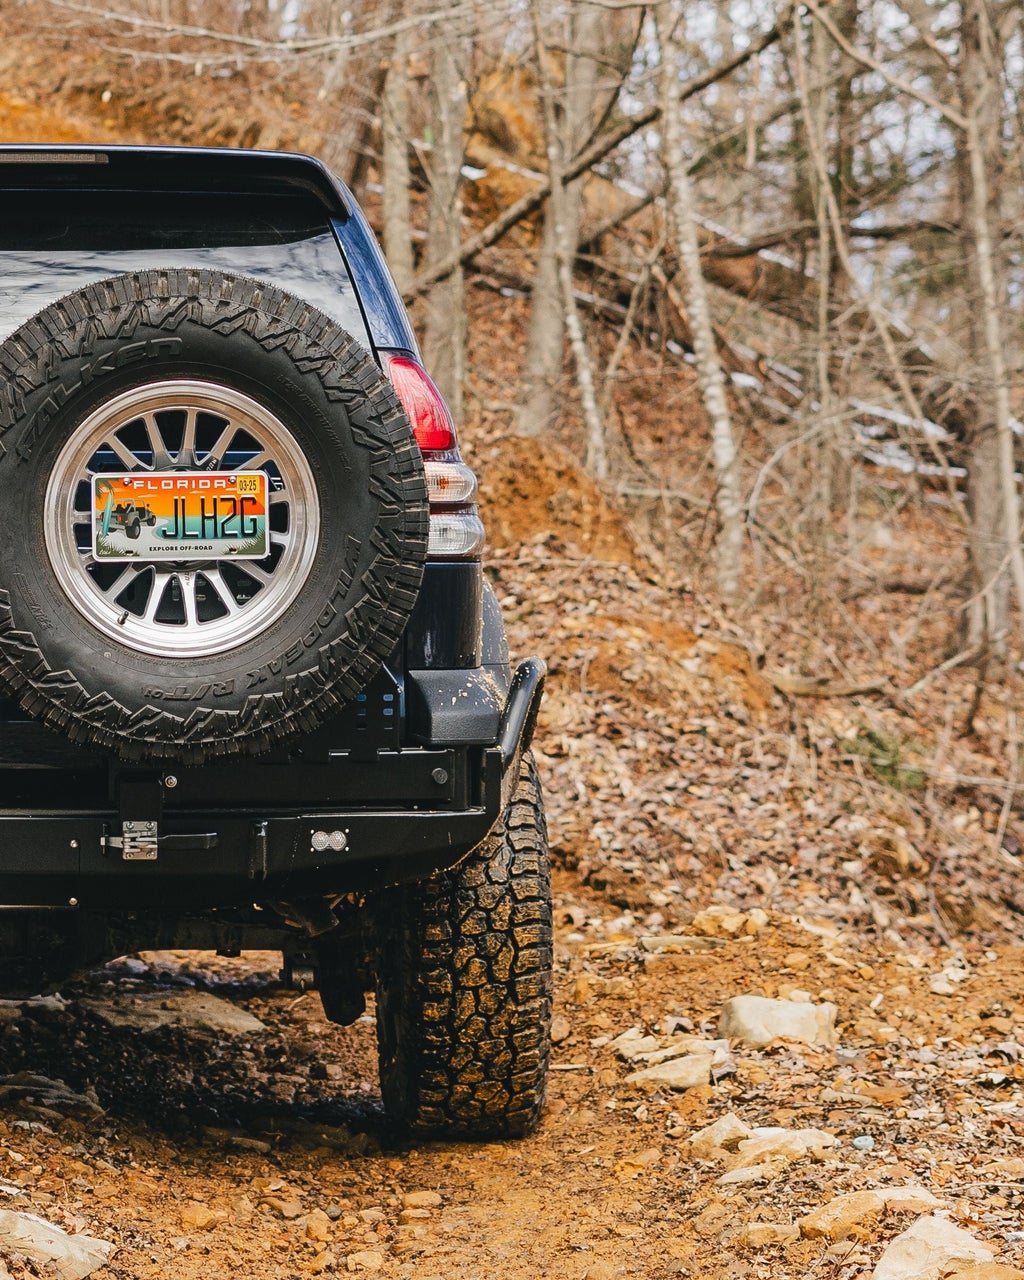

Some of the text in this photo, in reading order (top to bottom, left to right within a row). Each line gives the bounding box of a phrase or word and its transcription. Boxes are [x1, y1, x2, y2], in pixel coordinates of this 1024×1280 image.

[133, 479, 226, 490] FLORIDA
[239, 480, 257, 491] 03-25
[161, 495, 258, 538] JLH2G
[240, 534, 363, 689] WILDPEAK
